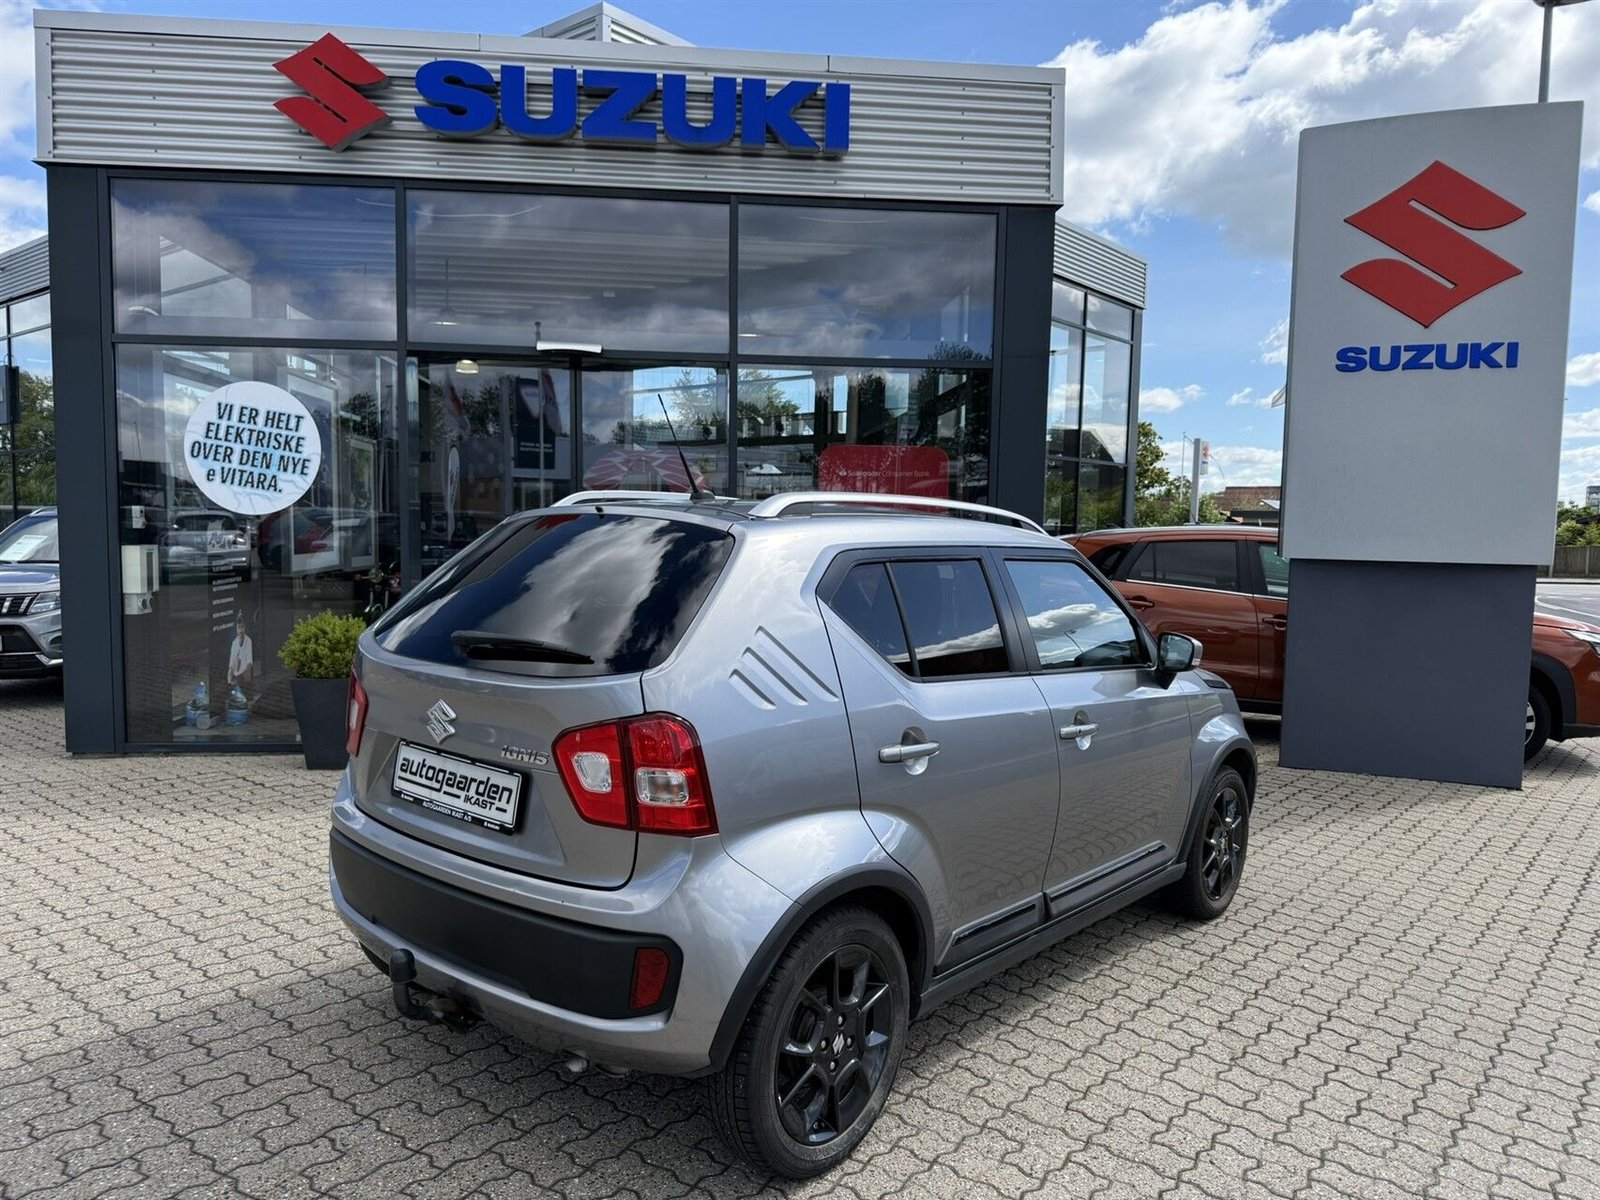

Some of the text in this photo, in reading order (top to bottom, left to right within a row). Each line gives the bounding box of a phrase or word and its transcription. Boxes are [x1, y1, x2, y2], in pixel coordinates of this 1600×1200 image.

[414, 60, 850, 155] SUZUKI
[1335, 342, 1519, 372] SUZUKI
[217, 402, 304, 432] VI ER HELT
[205, 422, 305, 454] ELEKTRISKE
[190, 441, 311, 476] OVER DEN NYE
[206, 467, 283, 493] e VITARA.
[501, 745, 549, 765] IGNIS
[400, 757, 513, 805] autogaarden
[422, 801, 452, 816] AUTOGAARDEN
[451, 811, 464, 821] IKAST
[463, 794, 496, 811] IKAST
